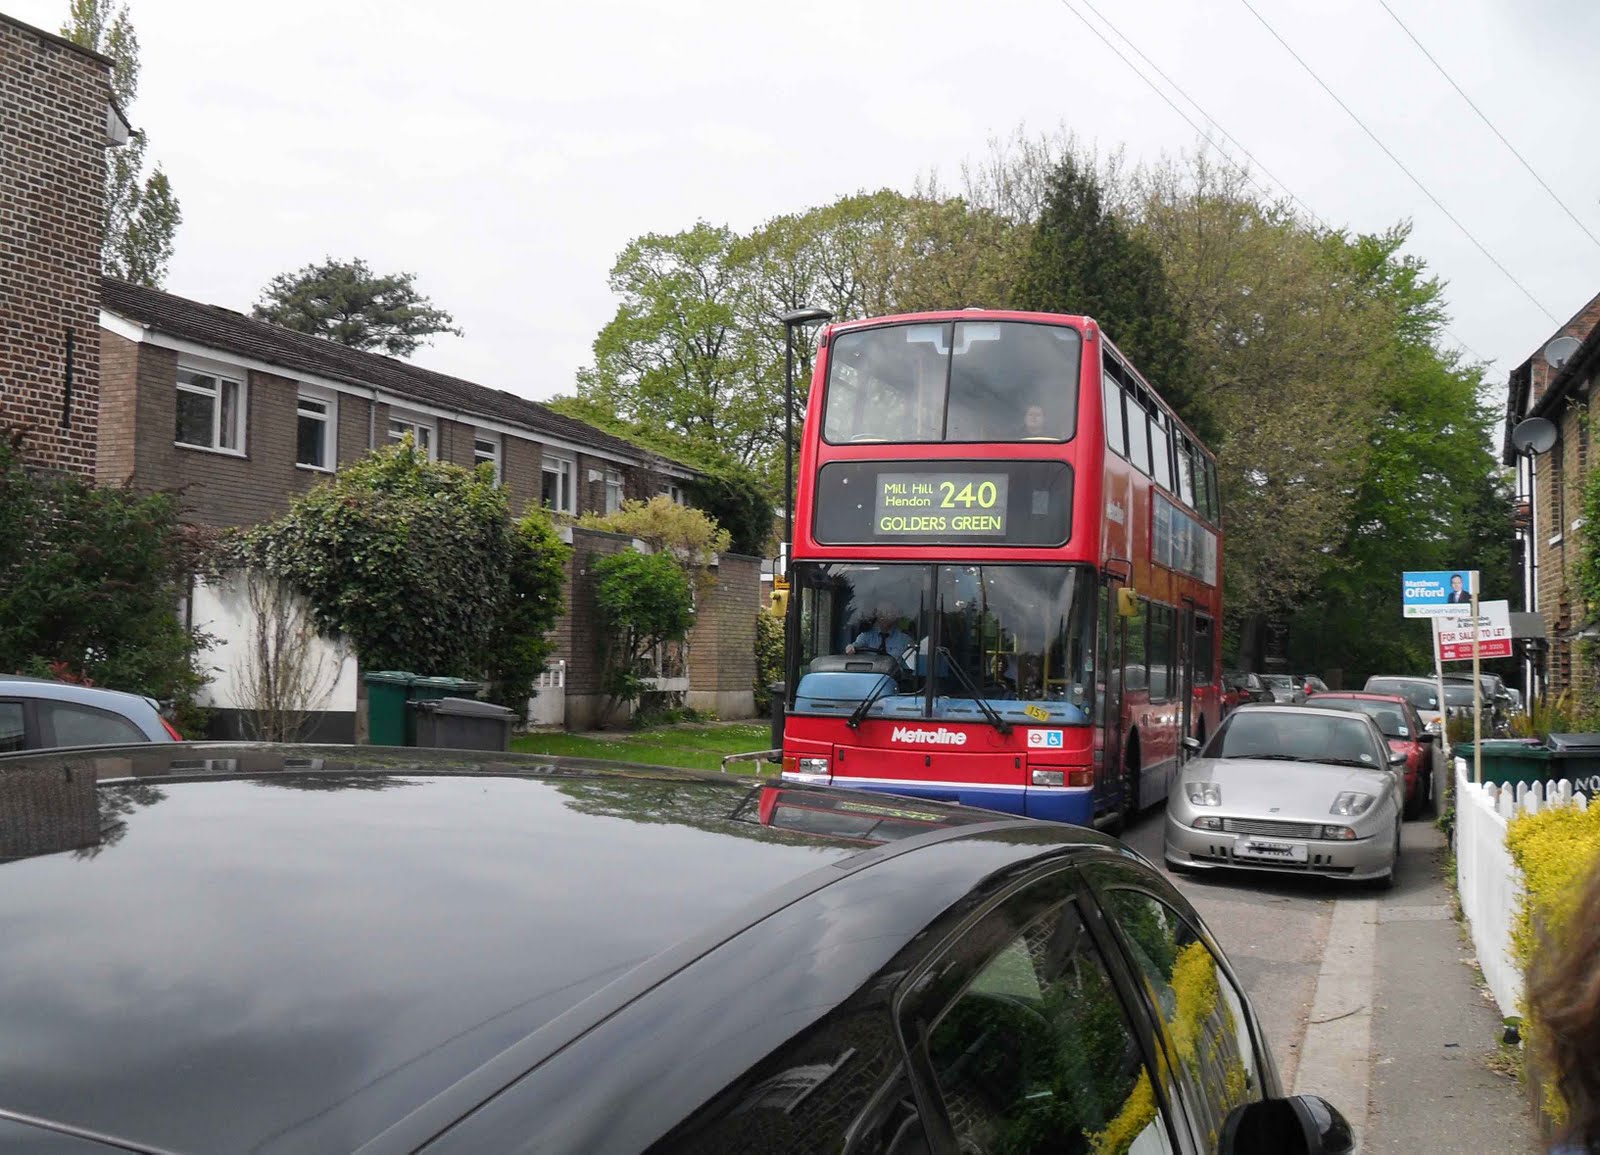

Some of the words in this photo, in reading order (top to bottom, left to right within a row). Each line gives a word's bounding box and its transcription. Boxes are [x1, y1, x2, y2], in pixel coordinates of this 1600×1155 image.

[884, 483, 907, 495] Mill
[911, 483, 933, 495] Hill
[939, 481, 997, 508] 240
[885, 495, 931, 507] Hendon
[880, 516, 946, 531] GOLDERS
[951, 515, 1001, 530] GREEN
[1405, 587, 1445, 598] Offord
[1442, 632, 1456, 641] FOR
[1459, 631, 1474, 641] SALE
[1482, 629, 1491, 638] TO
[1494, 627, 1506, 637] LET
[891, 726, 967, 746] Metroline
